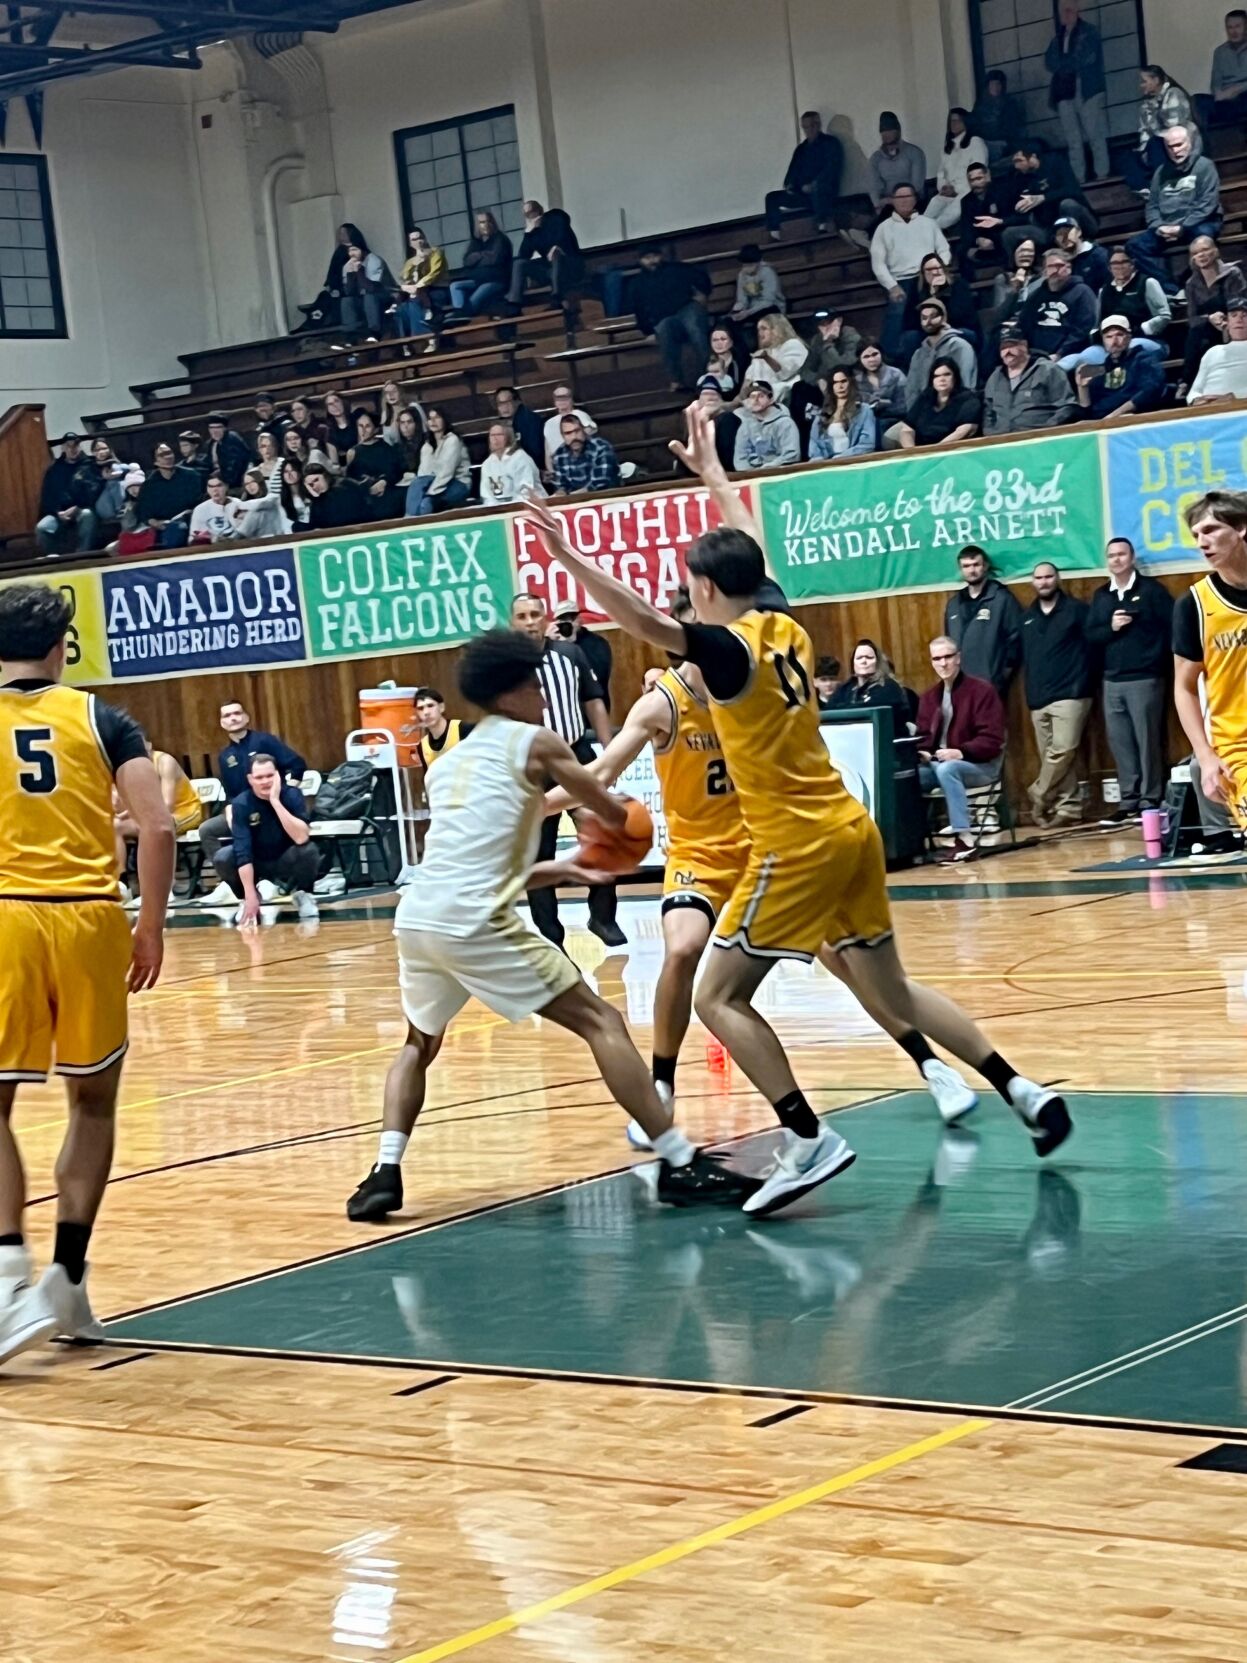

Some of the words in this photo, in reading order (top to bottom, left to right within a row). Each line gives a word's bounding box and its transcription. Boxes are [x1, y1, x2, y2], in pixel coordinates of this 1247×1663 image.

[1138, 439, 1225, 493] DEL
[514, 488, 741, 562] FOOTHIL
[780, 496, 889, 538] Welcome
[893, 489, 923, 521] to
[924, 477, 976, 516] the
[984, 463, 1064, 511] 83rd
[318, 530, 488, 599] COLFAX
[784, 523, 920, 566] KENDALL
[932, 506, 1067, 548] ARNETT
[107, 568, 296, 633] AMADOR
[318, 583, 497, 651] FALCONS
[108, 624, 239, 662] THUNDERING
[245, 618, 301, 646] HERD
[15, 728, 57, 793] 5
[707, 758, 735, 795] 2
